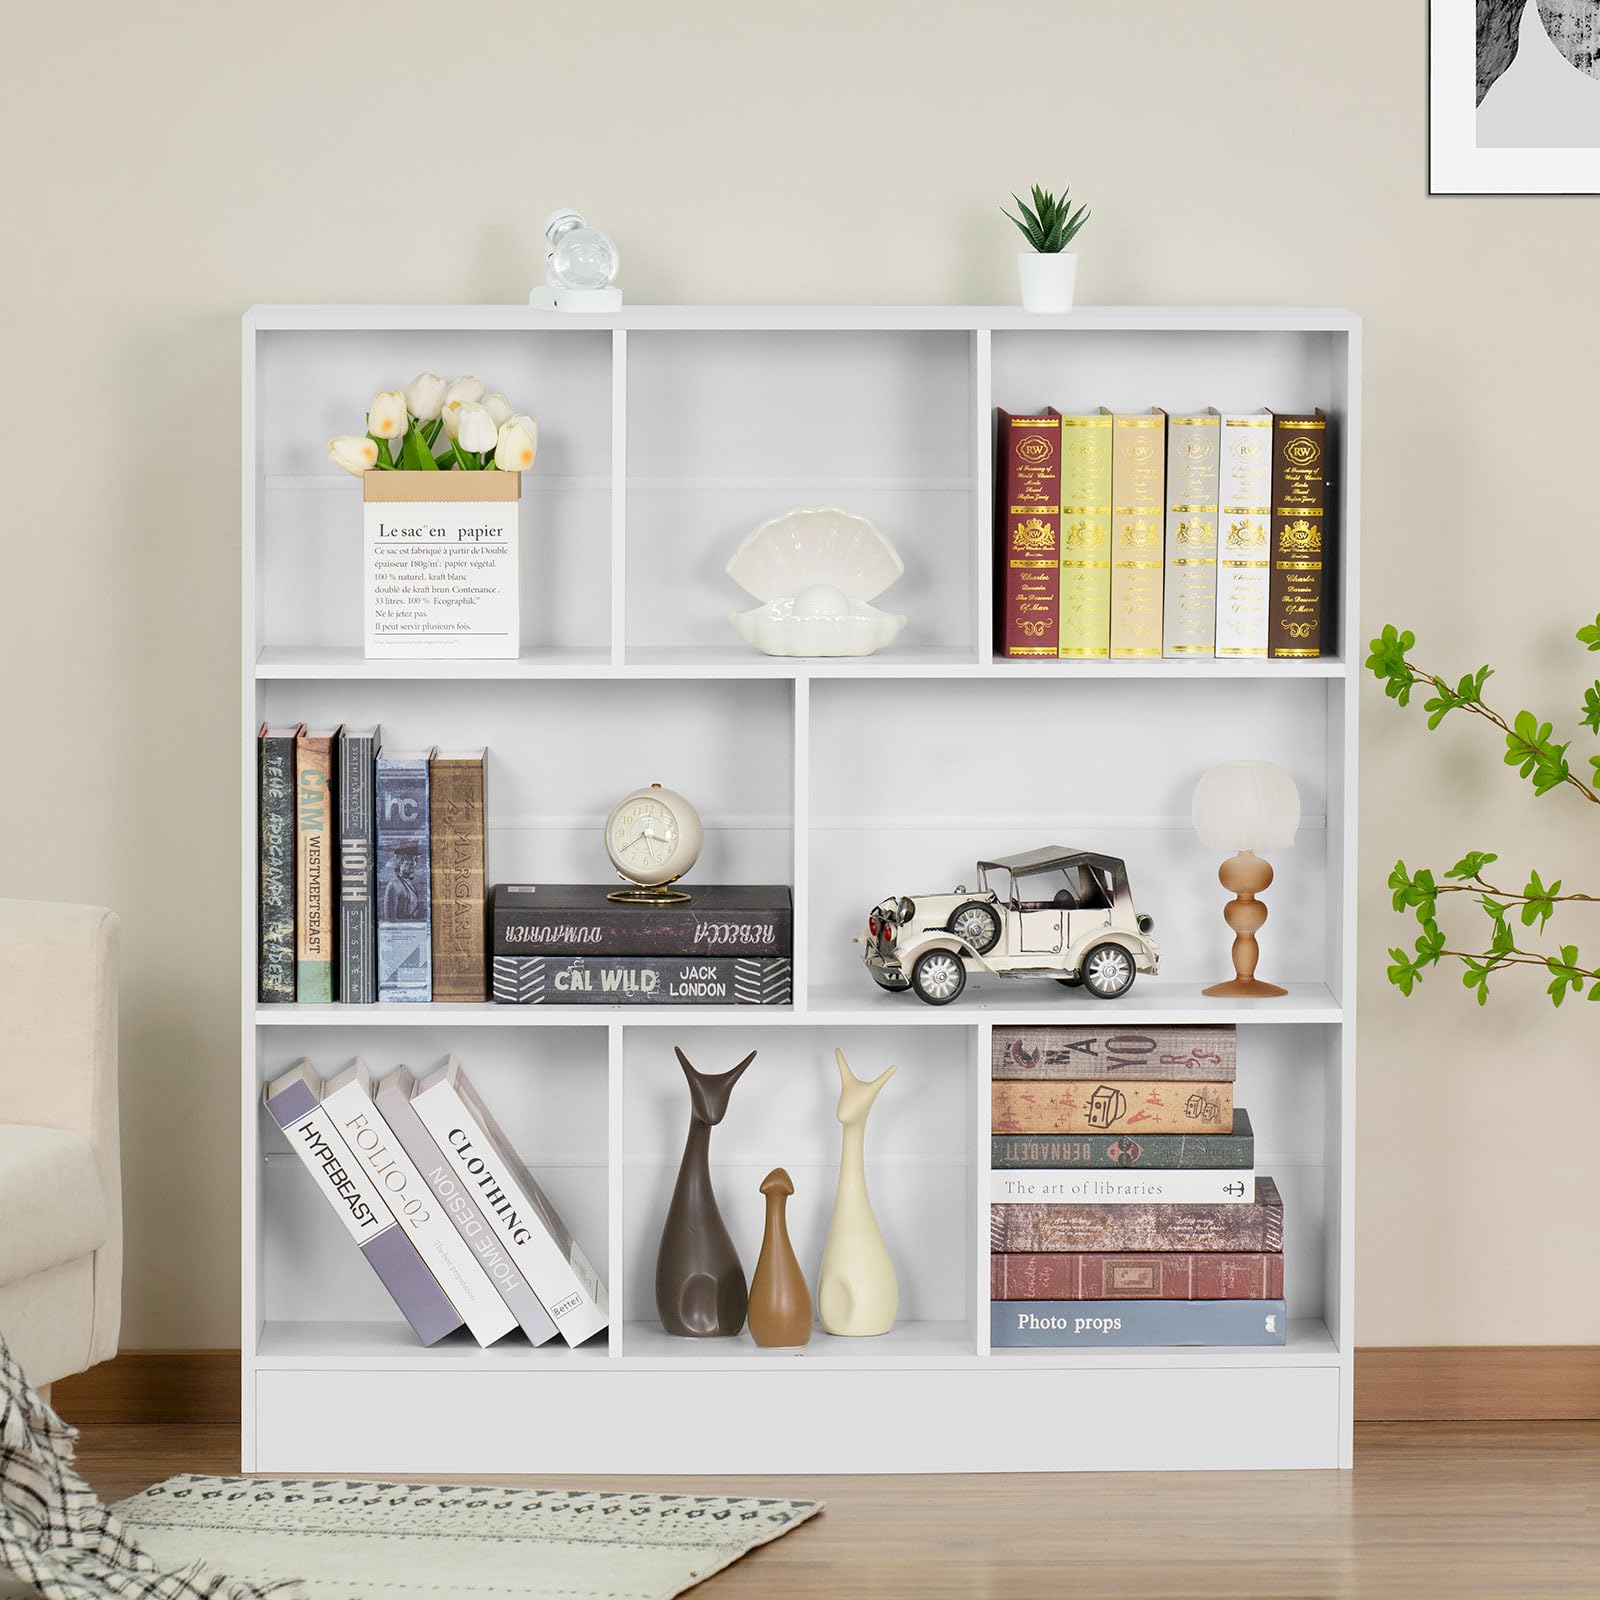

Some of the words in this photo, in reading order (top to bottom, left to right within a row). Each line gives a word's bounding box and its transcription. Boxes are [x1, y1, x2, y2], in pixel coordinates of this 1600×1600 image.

[1026, 445, 1044, 454] RW
[1294, 447, 1311, 457] RW
[379, 523, 398, 538] Le
[428, 527, 446, 537] en
[457, 524, 504, 541] papier
[1028, 530, 1041, 539] RW
[374, 546, 386, 555] Ce
[411, 546, 442, 557] fabriqué
[449, 547, 470, 557] partir
[470, 546, 481, 555] de
[481, 546, 509, 555] Double
[374, 560, 408, 570] épaisseur
[444, 560, 469, 569] papier
[469, 559, 497, 570] végétal.
[374, 573, 388, 581] 100
[388, 573, 397, 581] %
[397, 572, 427, 581] naturel.
[428, 572, 446, 581] kraft
[447, 572, 468, 581] blanc
[1020, 572, 1050, 581] Charles
[1286, 574, 1316, 583] Charles
[401, 585, 412, 594] de
[412, 585, 430, 594] kraft
[431, 585, 450, 594] brun
[451, 585, 497, 594] Contenance
[375, 597, 384, 605] 33
[385, 597, 406, 605] litres.
[408, 597, 421, 605] 100
[375, 609, 387, 617] Ne
[388, 609, 395, 617] le
[395, 610, 413, 619] jetez
[414, 611, 429, 619] pas.
[375, 622, 381, 630] Il
[382, 623, 399, 632] peut
[422, 621, 456, 632] plusieurs
[456, 621, 472, 630] fois.
[350, 746, 360, 773] SIXTH
[300, 769, 325, 832] CAM
[342, 839, 368, 902] HOTH
[309, 835, 321, 954] WESTMEETSEAST
[505, 925, 602, 944] DUMAURIER
[694, 922, 776, 945] REBECCA
[554, 969, 593, 991] CAL
[600, 969, 657, 992] WILD
[680, 966, 717, 981] JACK
[670, 982, 726, 998] LONDON
[298, 1121, 379, 1228] HYPEBEAST
[345, 1113, 430, 1229] FOLIO-02
[448, 1128, 532, 1246] CLOTHING
[1005, 1180, 1035, 1195] The
[1042, 1183, 1064, 1195] art
[1071, 1181, 1090, 1195] of
[1094, 1181, 1163, 1195] libraries
[474, 1235, 520, 1292] HOME
[553, 1296, 580, 1316] Better
[1017, 1313, 1067, 1330] Photo
[1074, 1317, 1122, 1334] props
